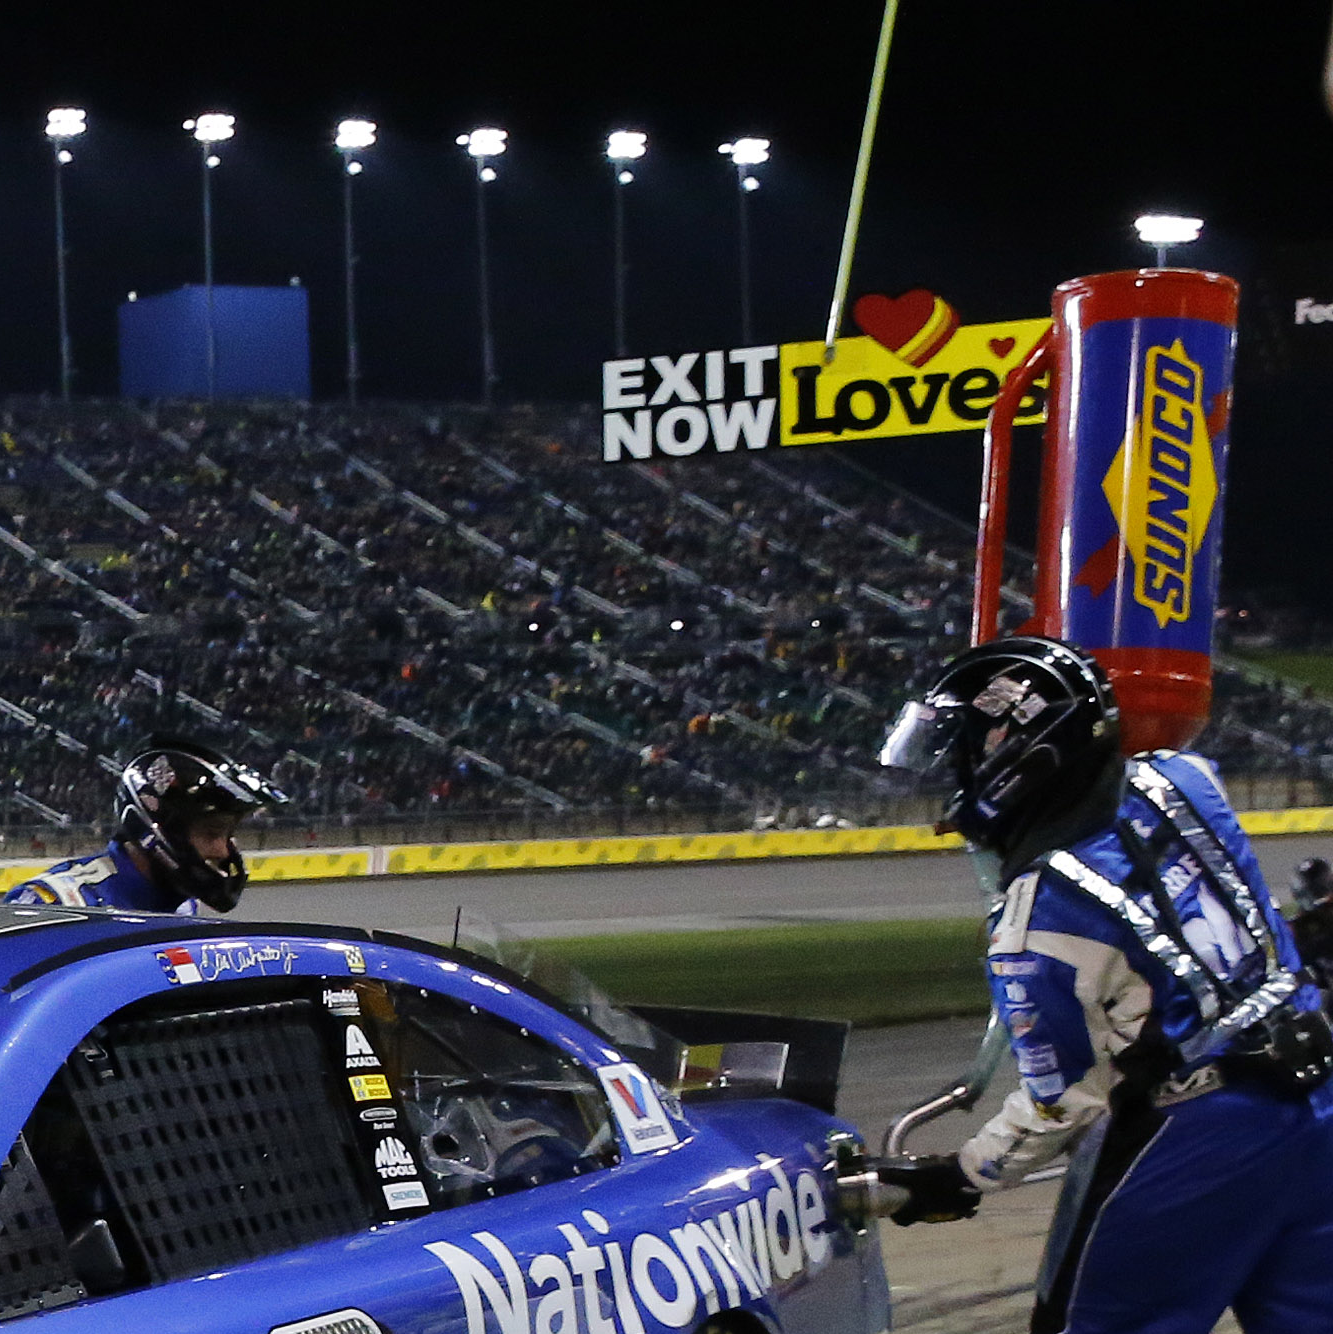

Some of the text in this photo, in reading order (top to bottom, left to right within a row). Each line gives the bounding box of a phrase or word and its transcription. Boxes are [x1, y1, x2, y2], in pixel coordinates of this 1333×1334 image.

[602, 344, 779, 410] EXIT
[602, 398, 778, 463] NOW
[1143, 352, 1198, 603] SUNOCO
[374, 1136, 414, 1168] MAC
[376, 1164, 418, 1179] TOOLS
